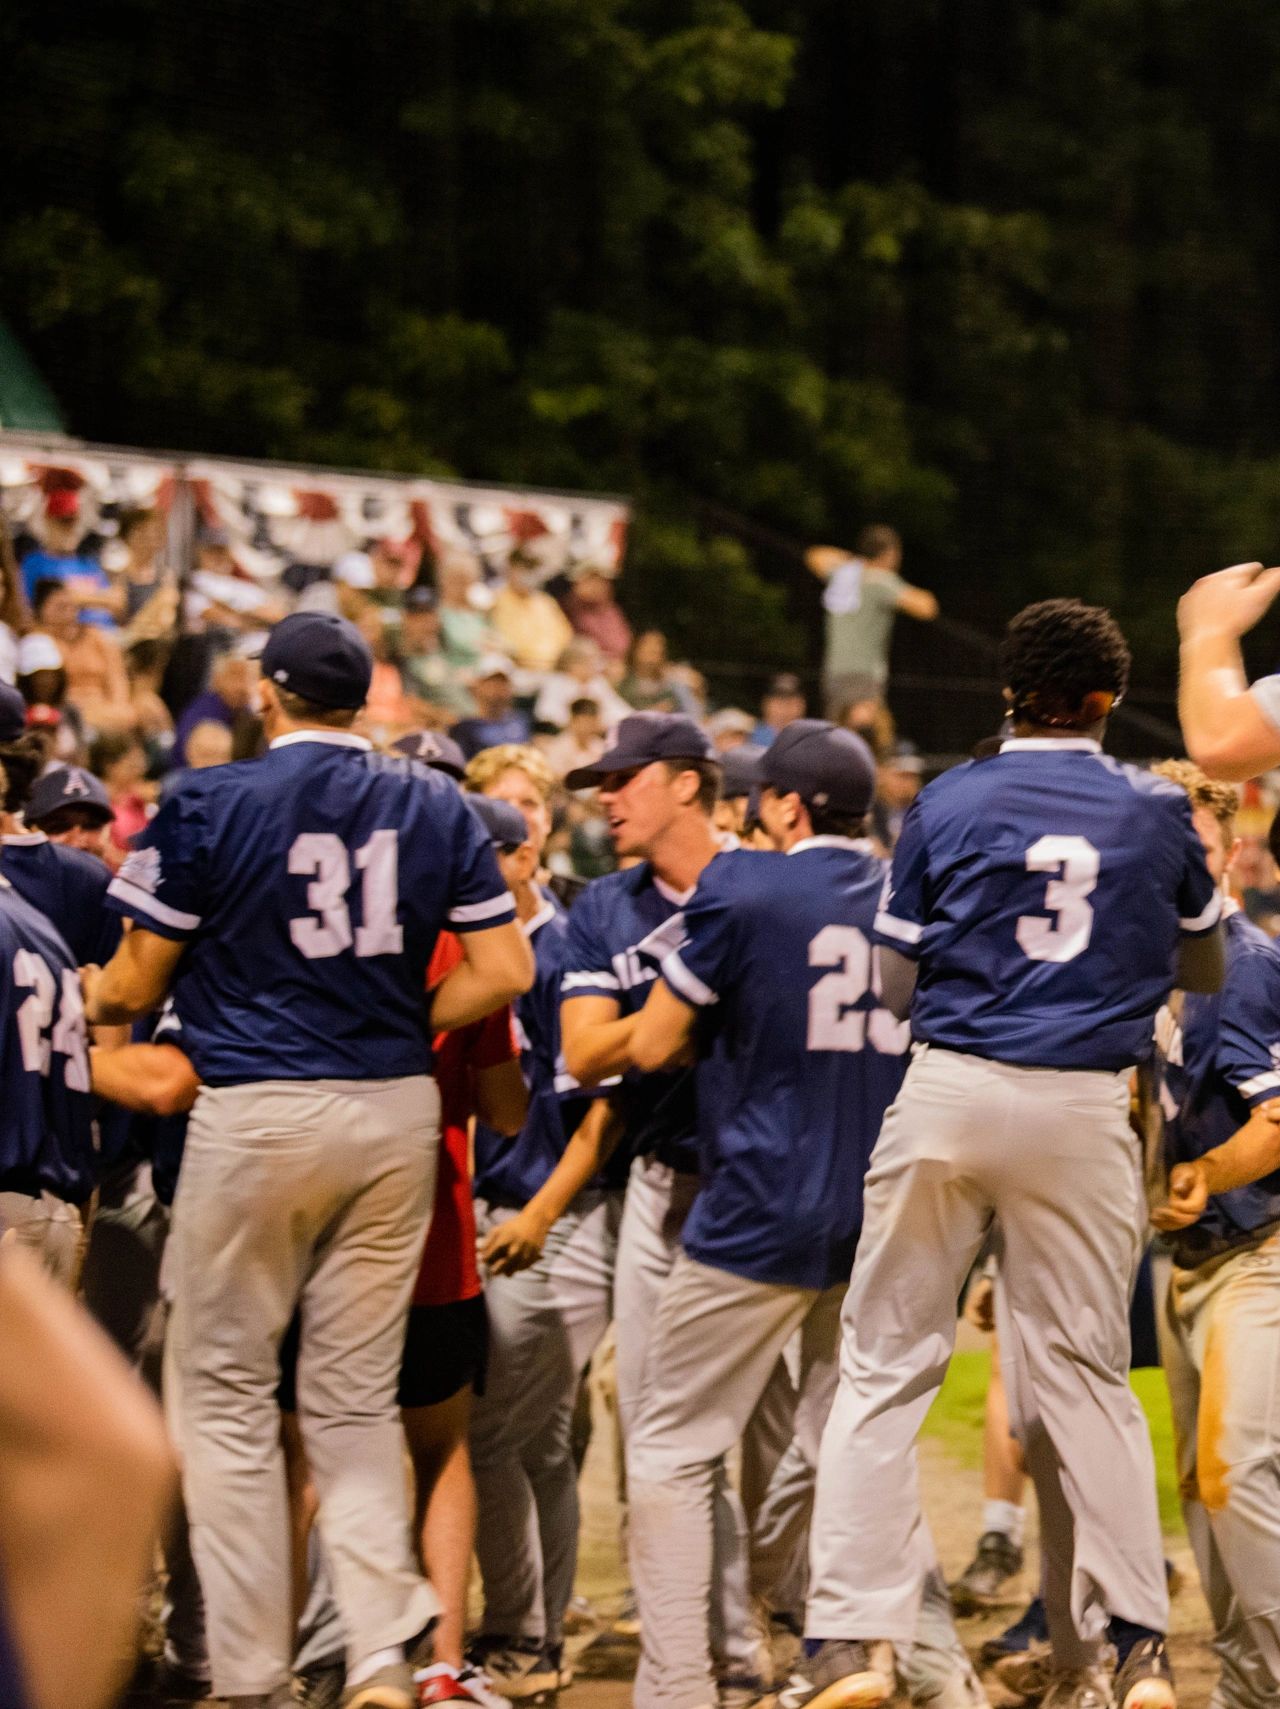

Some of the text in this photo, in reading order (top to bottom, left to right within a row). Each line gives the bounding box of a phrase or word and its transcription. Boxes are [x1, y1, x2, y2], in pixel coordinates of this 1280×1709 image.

[63, 767, 90, 796] A
[287, 828, 404, 959] 31
[1015, 834, 1100, 963] 3
